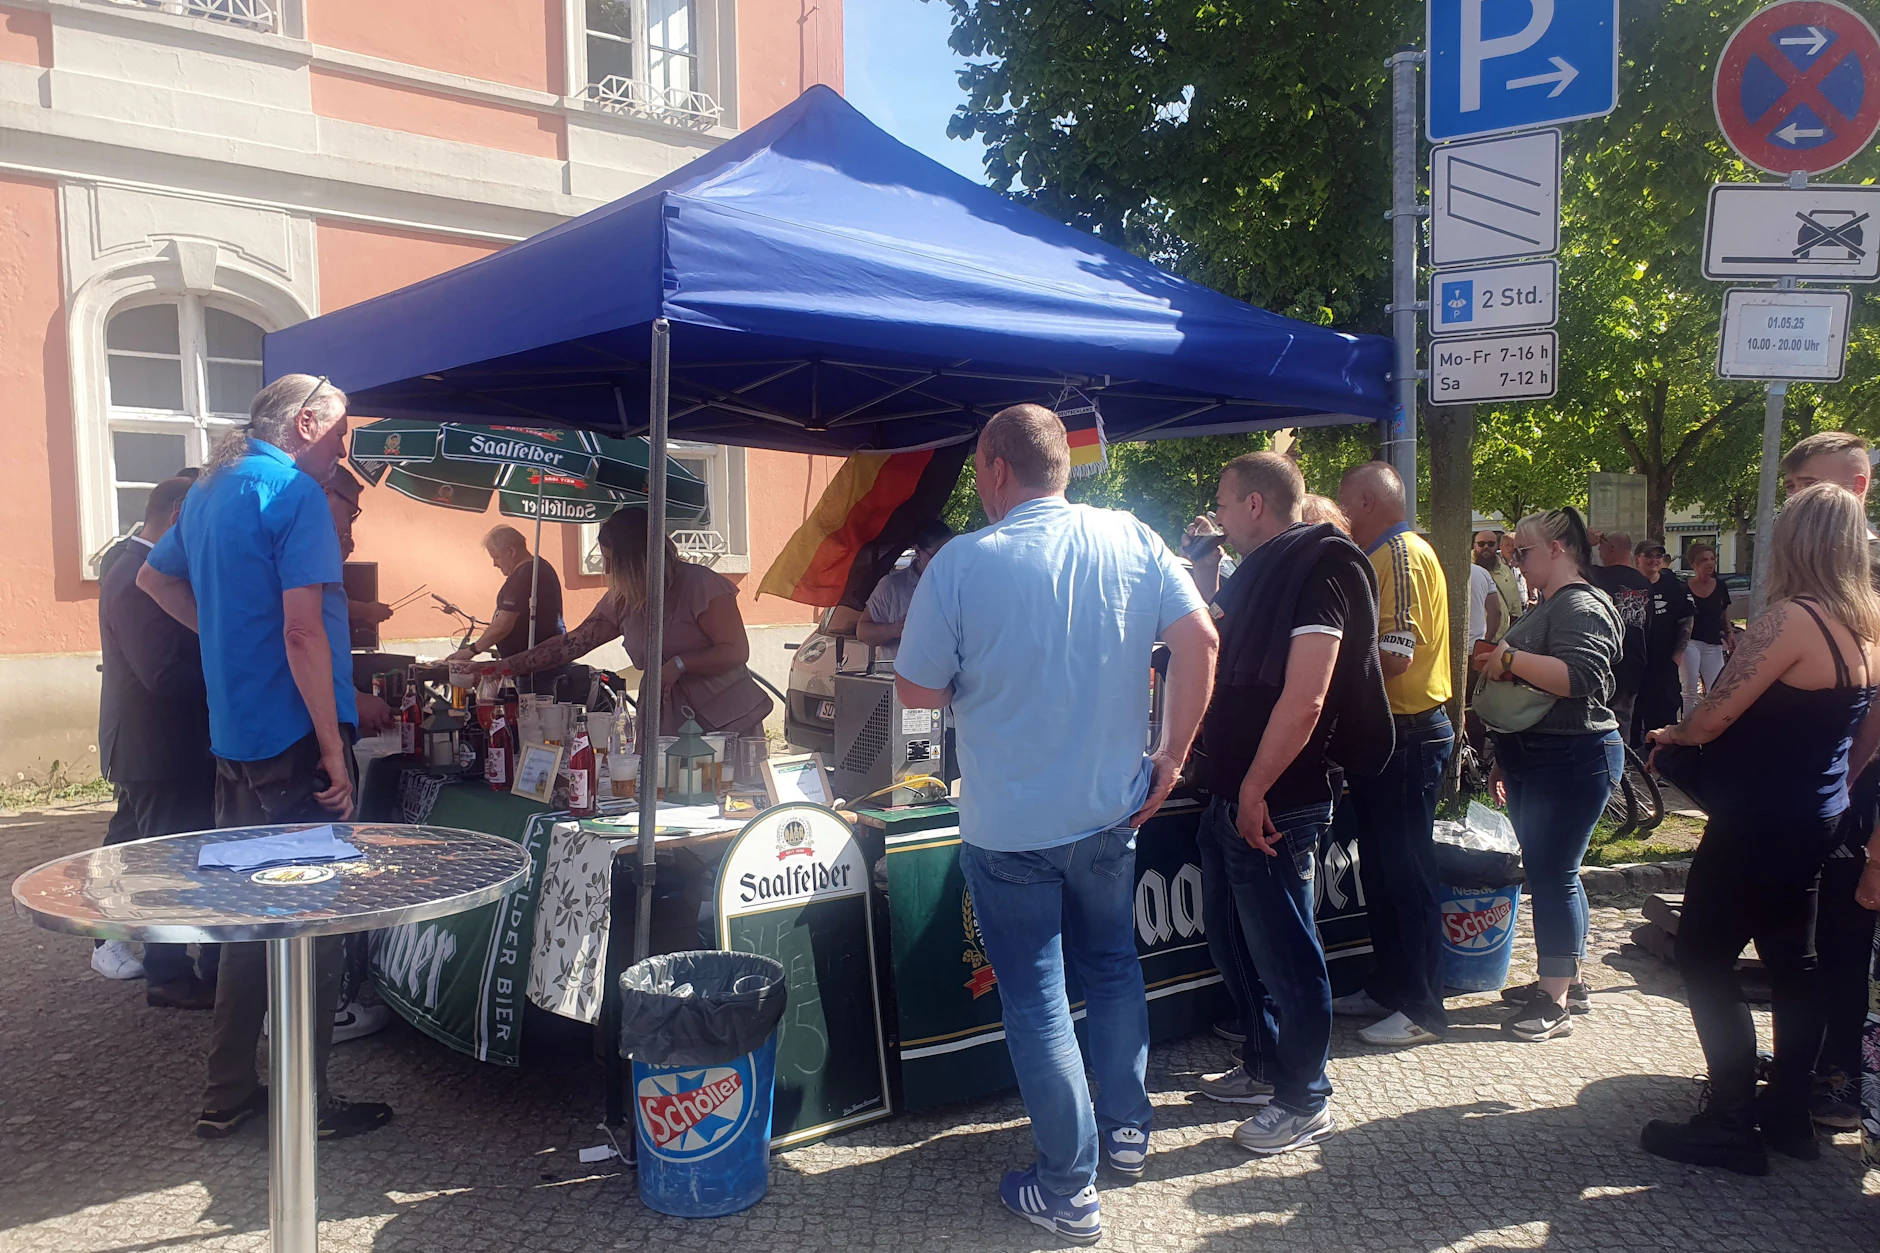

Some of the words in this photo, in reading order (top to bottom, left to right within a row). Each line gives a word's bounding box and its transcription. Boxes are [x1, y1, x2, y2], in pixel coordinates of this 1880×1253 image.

[1459, 0, 1555, 113] P
[1482, 290, 1494, 309] 2
[1500, 285, 1543, 307] Std.
[1767, 316, 1805, 330] 01.05.25
[1439, 350, 1492, 367] Mo-Fr
[1500, 346, 1534, 362] 7-16
[1540, 345, 1548, 359] h
[1747, 338, 1771, 350] 10.00
[1778, 339, 1802, 351] 20.00
[1804, 339, 1820, 352] Uhr
[1440, 377, 1460, 391] Sa
[1500, 371, 1534, 387] 7-12
[1540, 370, 1548, 384] h
[1057, 407, 1094, 417] DEUTSCHLAND
[469, 435, 564, 466] Saalfelder
[740, 862, 851, 902] Saalfelder
[1446, 902, 1511, 943] Schöller
[496, 976, 514, 1041] BIER
[645, 1074, 738, 1143] Schöller
